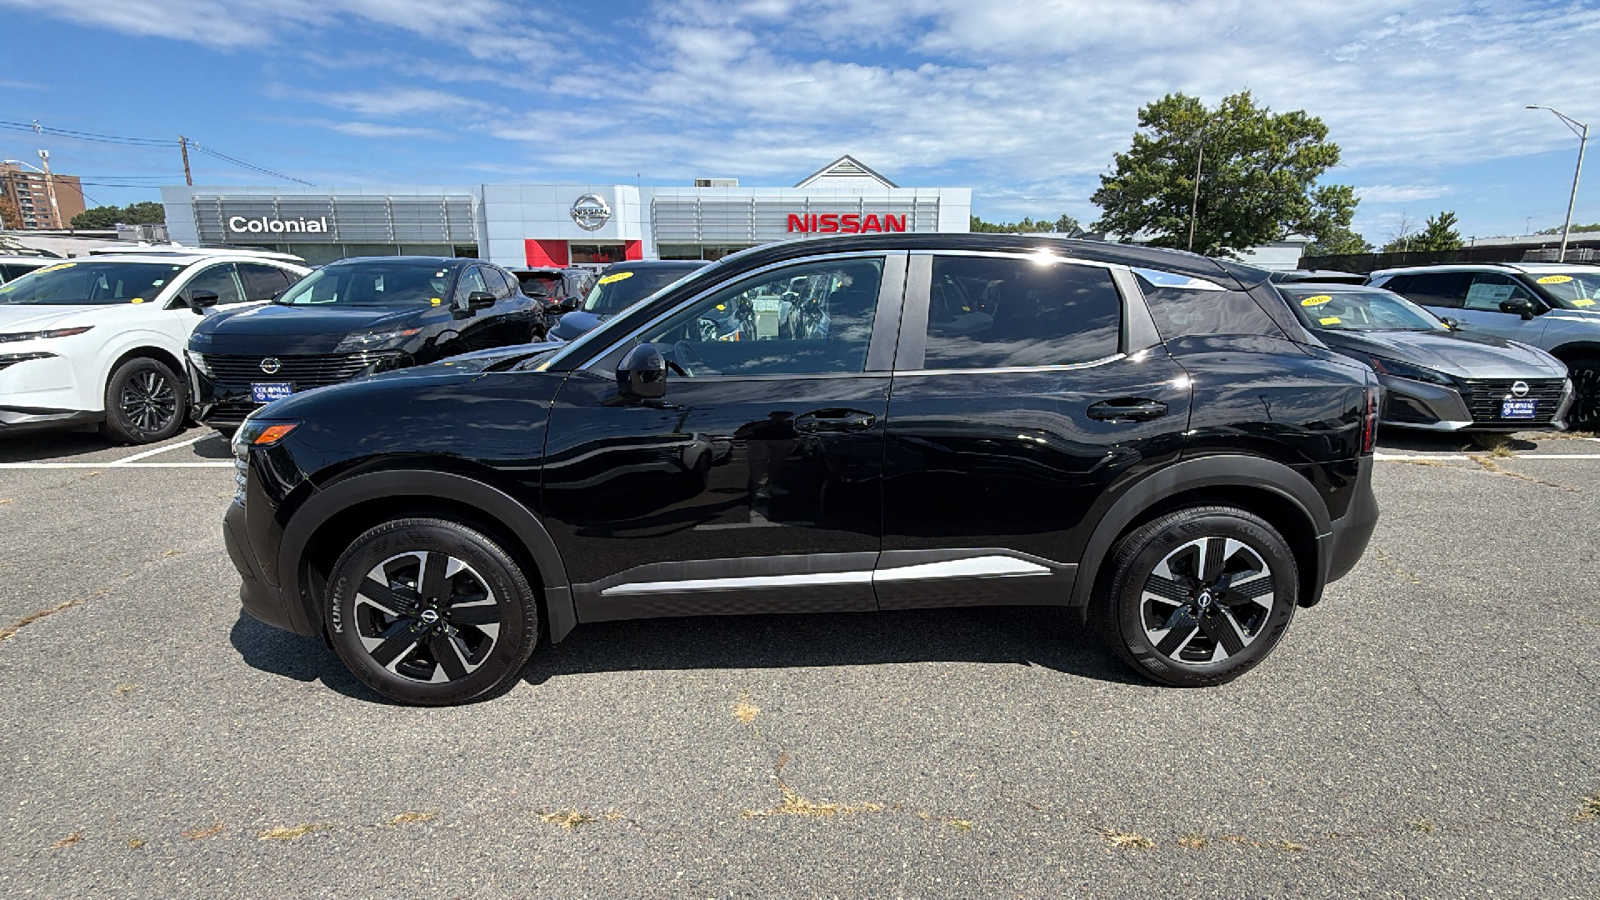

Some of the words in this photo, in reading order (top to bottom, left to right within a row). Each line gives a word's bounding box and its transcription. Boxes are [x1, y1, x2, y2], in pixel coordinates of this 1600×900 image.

[229, 216, 328, 233] Colonial
[787, 213, 907, 233] NISSAN
[332, 576, 347, 634] KUMHO
